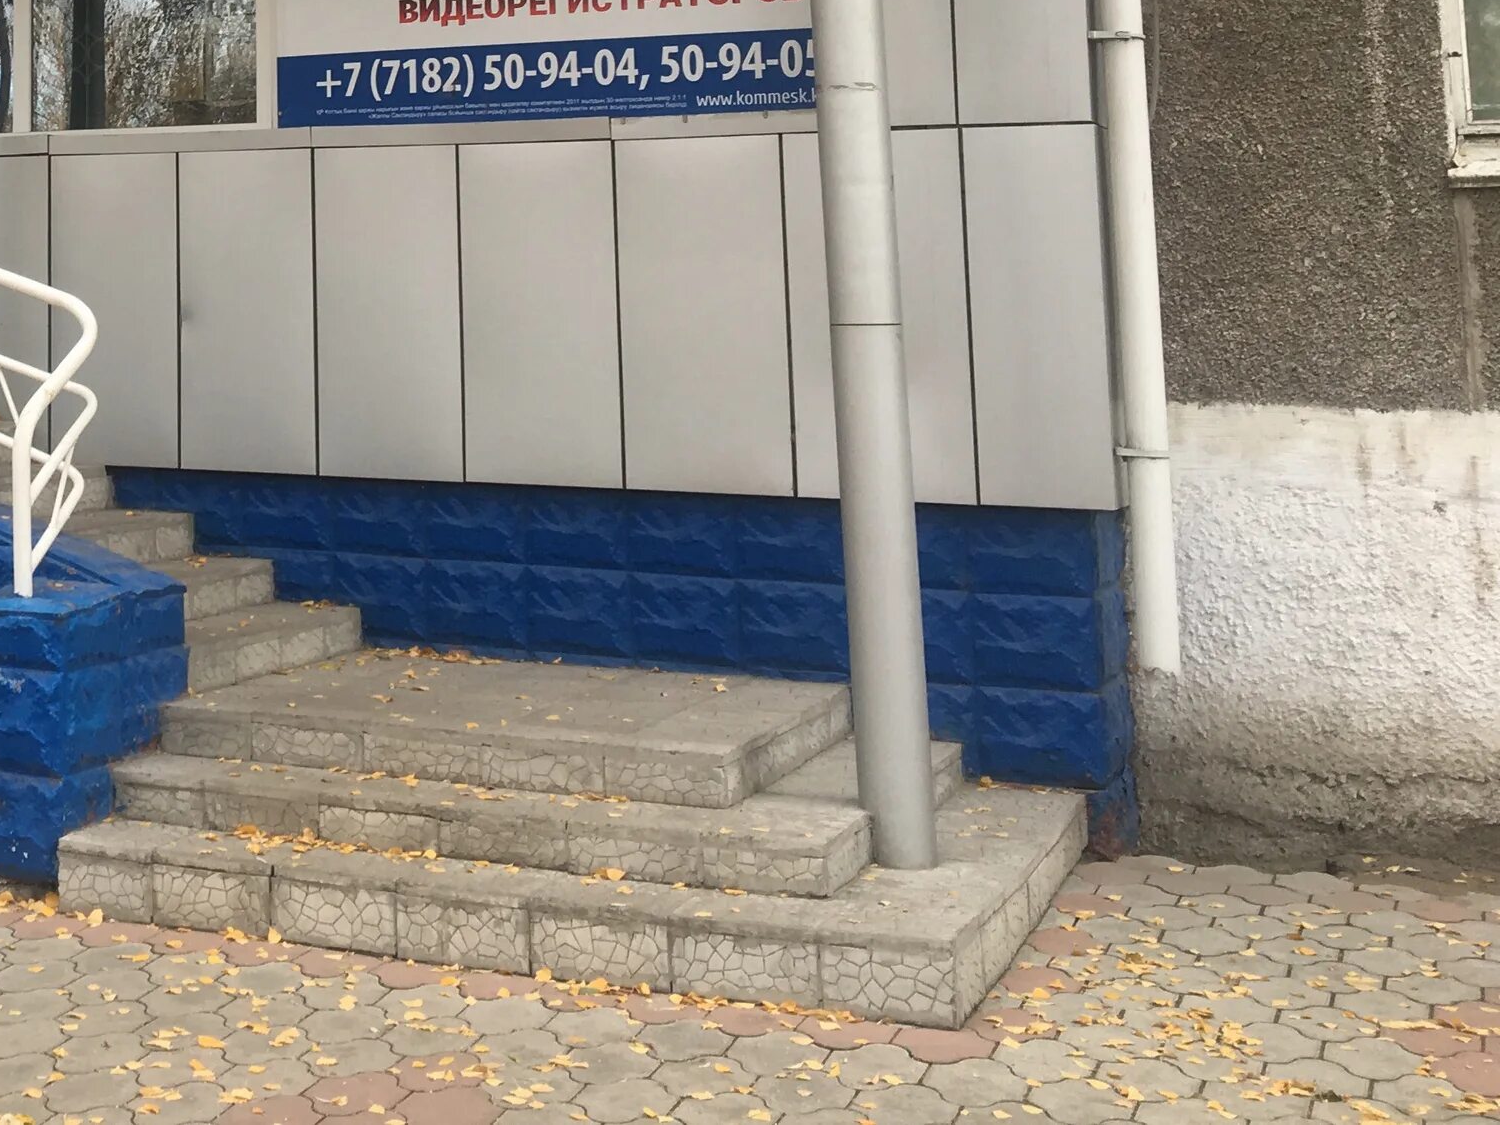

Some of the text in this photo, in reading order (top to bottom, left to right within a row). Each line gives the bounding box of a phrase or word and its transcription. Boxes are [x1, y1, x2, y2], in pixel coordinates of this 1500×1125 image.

[316, 62, 361, 99] +7
[371, 53, 475, 101] (7182)
[483, 47, 650, 92] 50-94-04,
